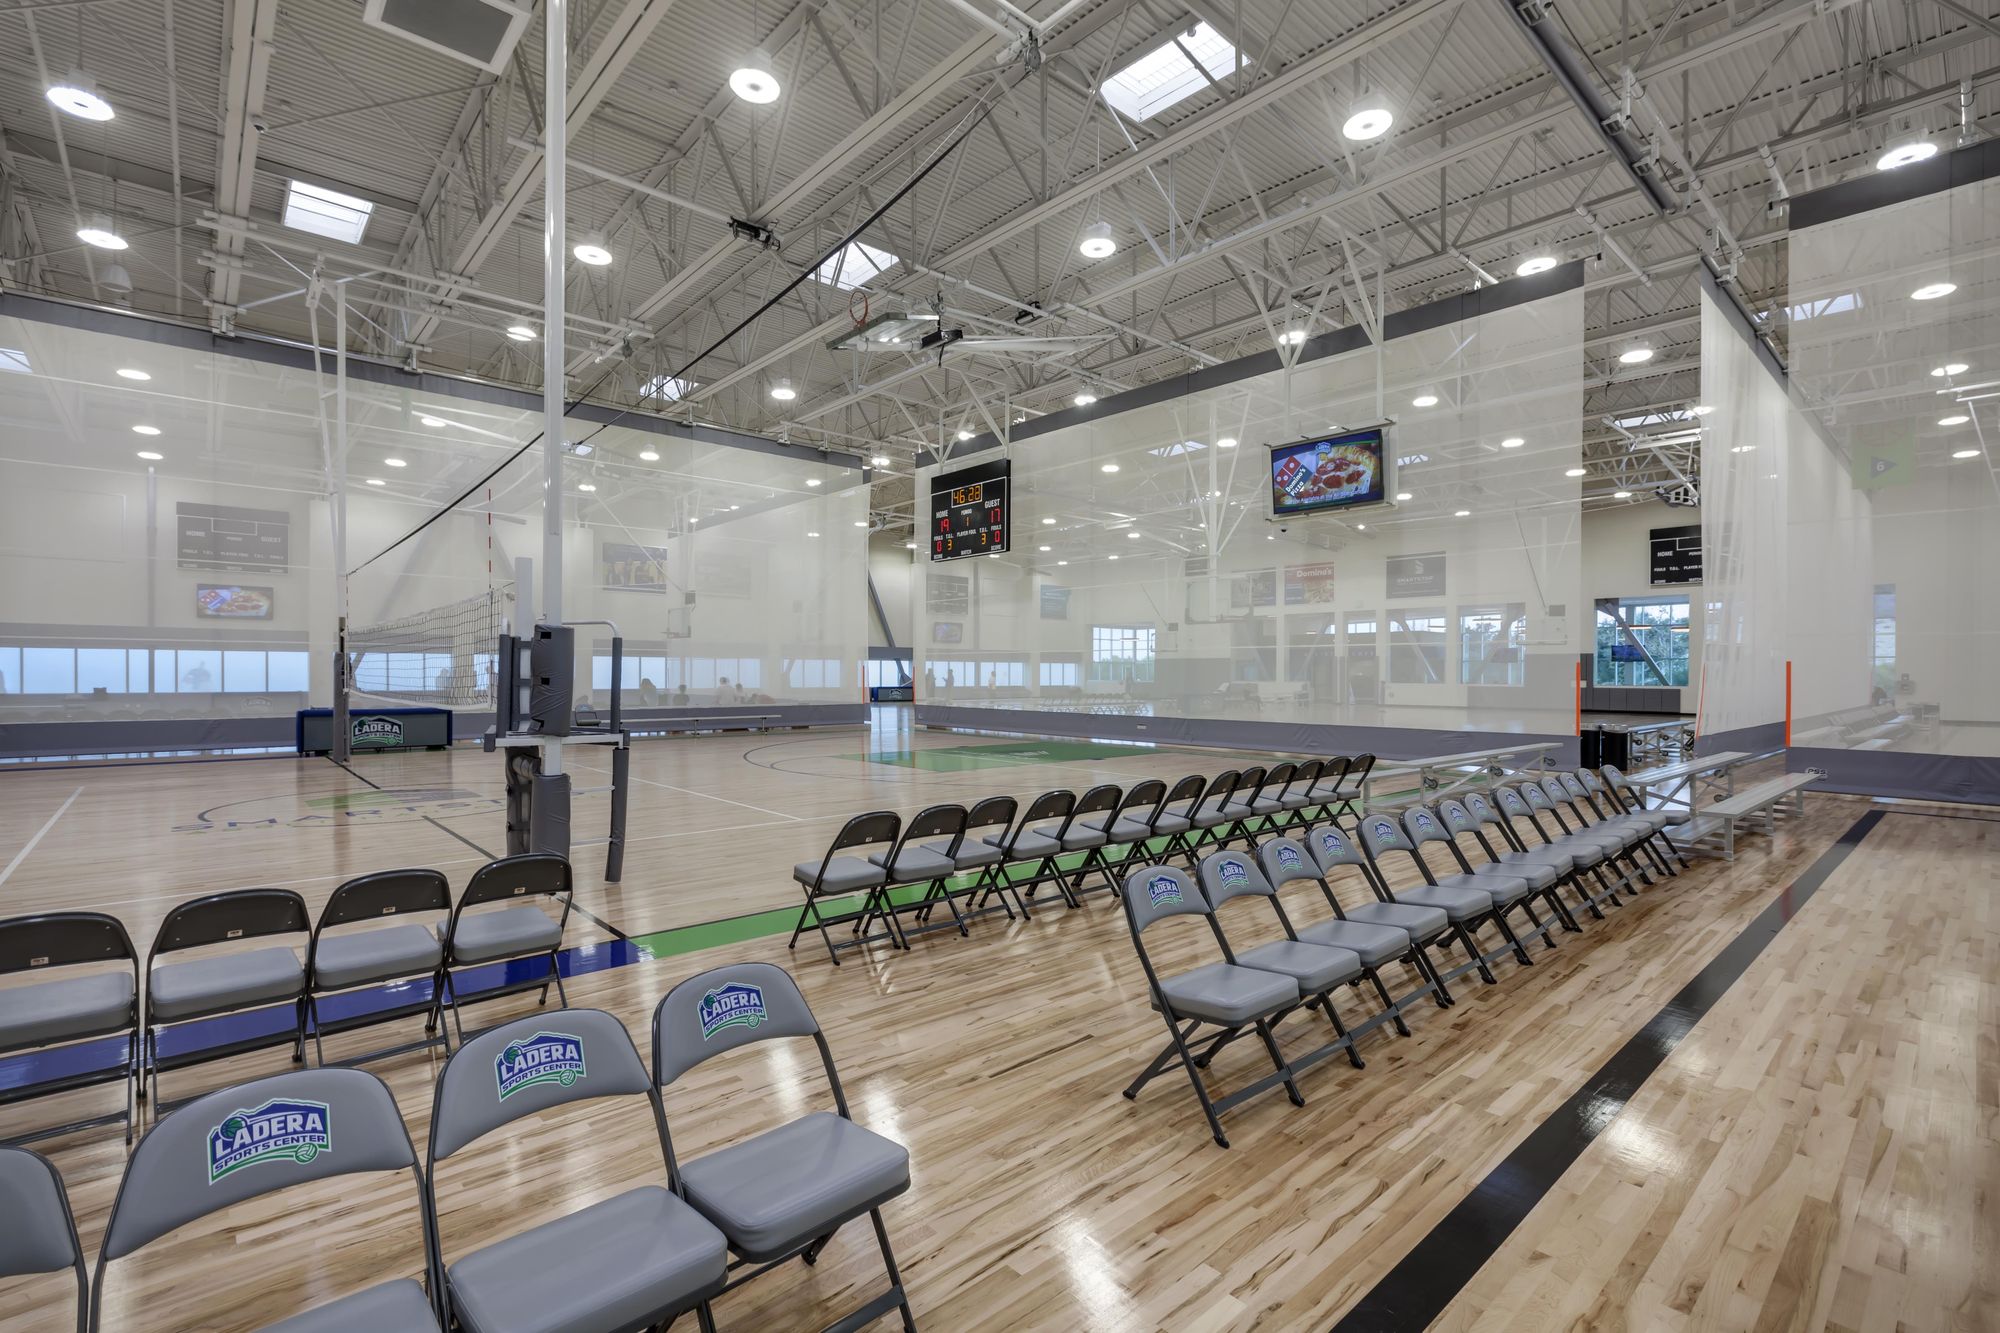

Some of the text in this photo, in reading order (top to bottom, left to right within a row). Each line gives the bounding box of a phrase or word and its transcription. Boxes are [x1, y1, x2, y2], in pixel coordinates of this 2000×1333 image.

[1285, 467, 1306, 492] Domino's
[1290, 481, 1304, 496] Pizza
[985, 499, 1000, 508] GUEST
[936, 510, 948, 518] HOME
[990, 508, 1001, 523] 17
[1296, 568, 1332, 577] Domino's
[354, 723, 401, 736] LADERA
[1151, 882, 1178, 898] LADERA
[702, 992, 761, 1023] LADERA
[705, 1008, 763, 1031] SPORTS CENTER
[500, 1044, 579, 1081] LADERA
[502, 1062, 581, 1092] SPORTS CENTER
[214, 1113, 324, 1160] LADERA
[214, 1134, 326, 1173] SPORTS CENTER
